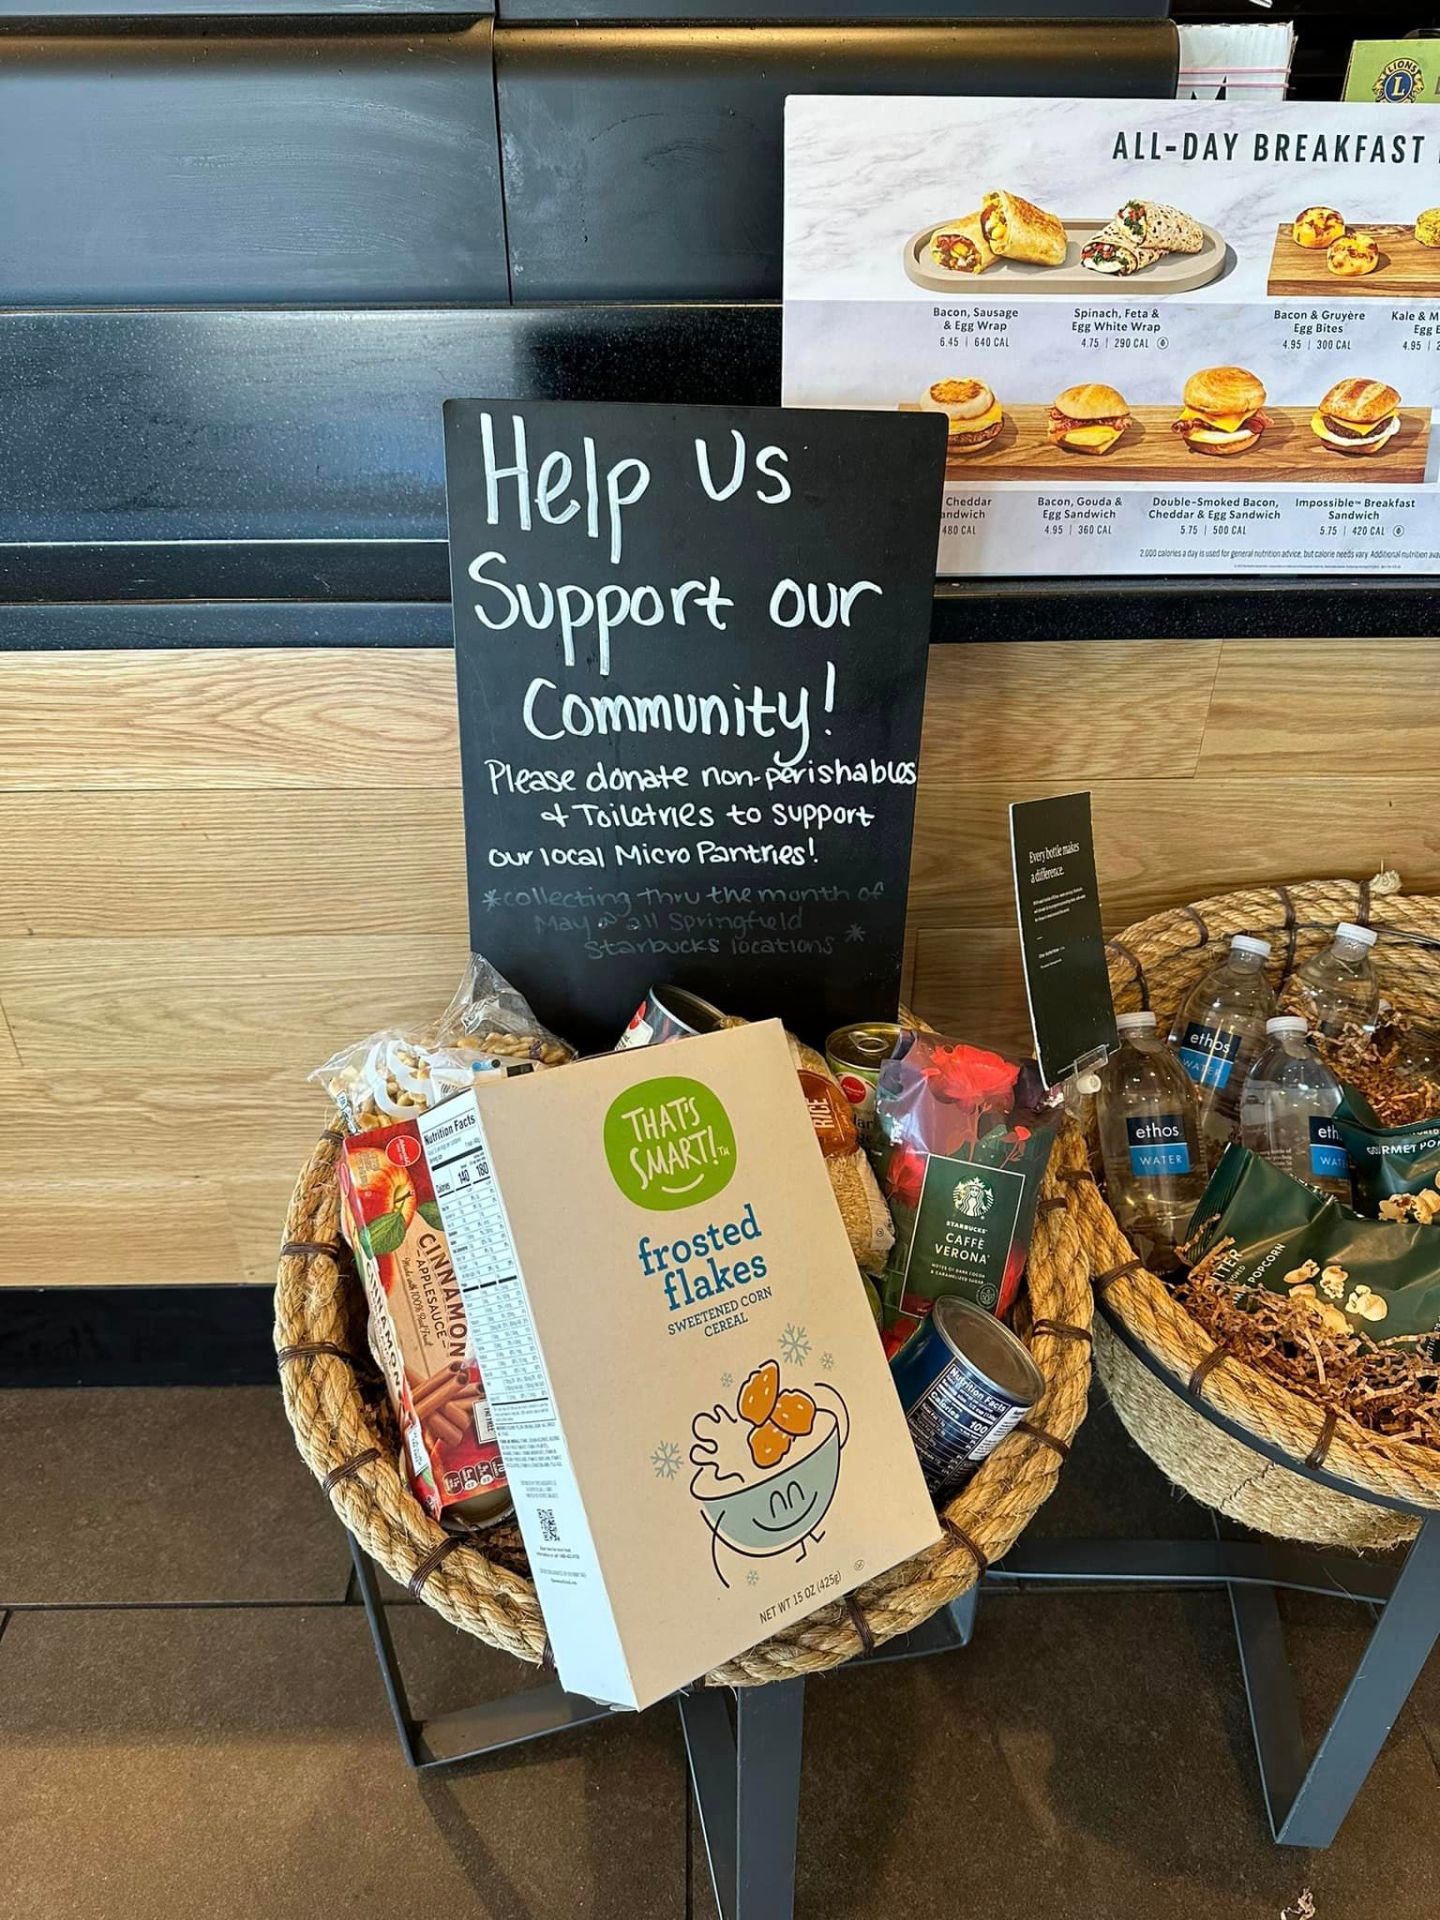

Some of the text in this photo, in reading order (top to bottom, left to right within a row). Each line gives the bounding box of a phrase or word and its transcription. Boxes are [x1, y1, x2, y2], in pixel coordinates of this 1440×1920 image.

[1387, 60, 1417, 73] LIONS
[1391, 76, 1406, 96] L
[1112, 131, 1425, 163] ALL-DAY BREAKFAST
[933, 307, 1019, 319] Bacon, Sausage
[1074, 308, 1160, 320] Spinach, Feta &
[1274, 309, 1366, 322] Bacon & Gruyère
[1391, 311, 1426, 321] Kale &
[943, 321, 1007, 332] & Egg Wrap
[1071, 321, 1161, 333] Egg White Wrap
[1294, 323, 1344, 334] Egg Bites
[1414, 324, 1433, 336] Egg
[939, 336, 1009, 347] 6.45 640 CAL
[1081, 337, 1149, 348] 4.75 290 CAL
[1282, 339, 1351, 350] 4.95 300 CAL
[1402, 340, 1422, 351] 4.95
[479, 411, 793, 564] Help Us
[946, 496, 992, 507] Cheddar
[1037, 497, 1123, 508] Bacon, Gouda &
[1152, 497, 1279, 508] Double-Smoked Bacon,
[1364, 498, 1416, 508] Breakfast
[941, 509, 985, 519] andwich
[1043, 509, 1116, 521] Egg Sandwich
[1148, 509, 1281, 521] Cheddar & Egg Sandwich
[1328, 510, 1380, 520] Sandwich
[942, 525, 976, 535] 480 CAL
[1044, 524, 1112, 535] 4.95 360 CAL
[1180, 525, 1246, 535] 5.75 500 CAL
[1319, 525, 1385, 536] 5.75 420 CAL
[467, 551, 735, 676] Support
[523, 660, 836, 765] Community!
[484, 759, 917, 795] Please donate non-perishables
[726, 804, 762, 826] to
[772, 804, 876, 830] support
[488, 838, 820, 869] our local Micro Pantries!
[1029, 850, 1046, 864] Every
[1045, 845, 1062, 860] bottle
[705, 885, 751, 905] the
[757, 886, 850, 905] month
[857, 881, 884, 903] of
[534, 914, 591, 938] May
[629, 911, 659, 931] all
[669, 907, 804, 939] Springfield
[730, 936, 837, 956] locations
[1189, 1032, 1231, 1054] ethos
[1182, 1058, 1222, 1078] WATER
[621, 1096, 701, 1142] THAT'S
[807, 1098, 835, 1129] RICE
[424, 1123, 454, 1145] Nutrition
[454, 1114, 476, 1132] Facts
[1135, 1122, 1180, 1139] ethos
[629, 1124, 719, 1191] SMART!
[1139, 1154, 1183, 1166] WATER
[457, 1169, 470, 1184] 140
[475, 1161, 489, 1176] 180
[946, 1220, 988, 1234] STARBUCKS
[638, 1202, 763, 1276] frosted
[945, 1232, 985, 1250] CAFFÈ
[1247, 1243, 1287, 1284] POPCORN
[664, 1255, 768, 1311] flakes
[411, 1288, 423, 1314] 100%
[418, 1233, 468, 1357] CINNAMON
[667, 1286, 773, 1336] SWEETENED CORN
[704, 1311, 749, 1337] CEREAL
[949, 1367, 985, 1401] Nutrition
[984, 1395, 1007, 1413] Facts
[930, 1391, 960, 1420] Calories
[969, 1420, 989, 1435] 100
[759, 1570, 842, 1624] NET WT 15 OZ (425g)
